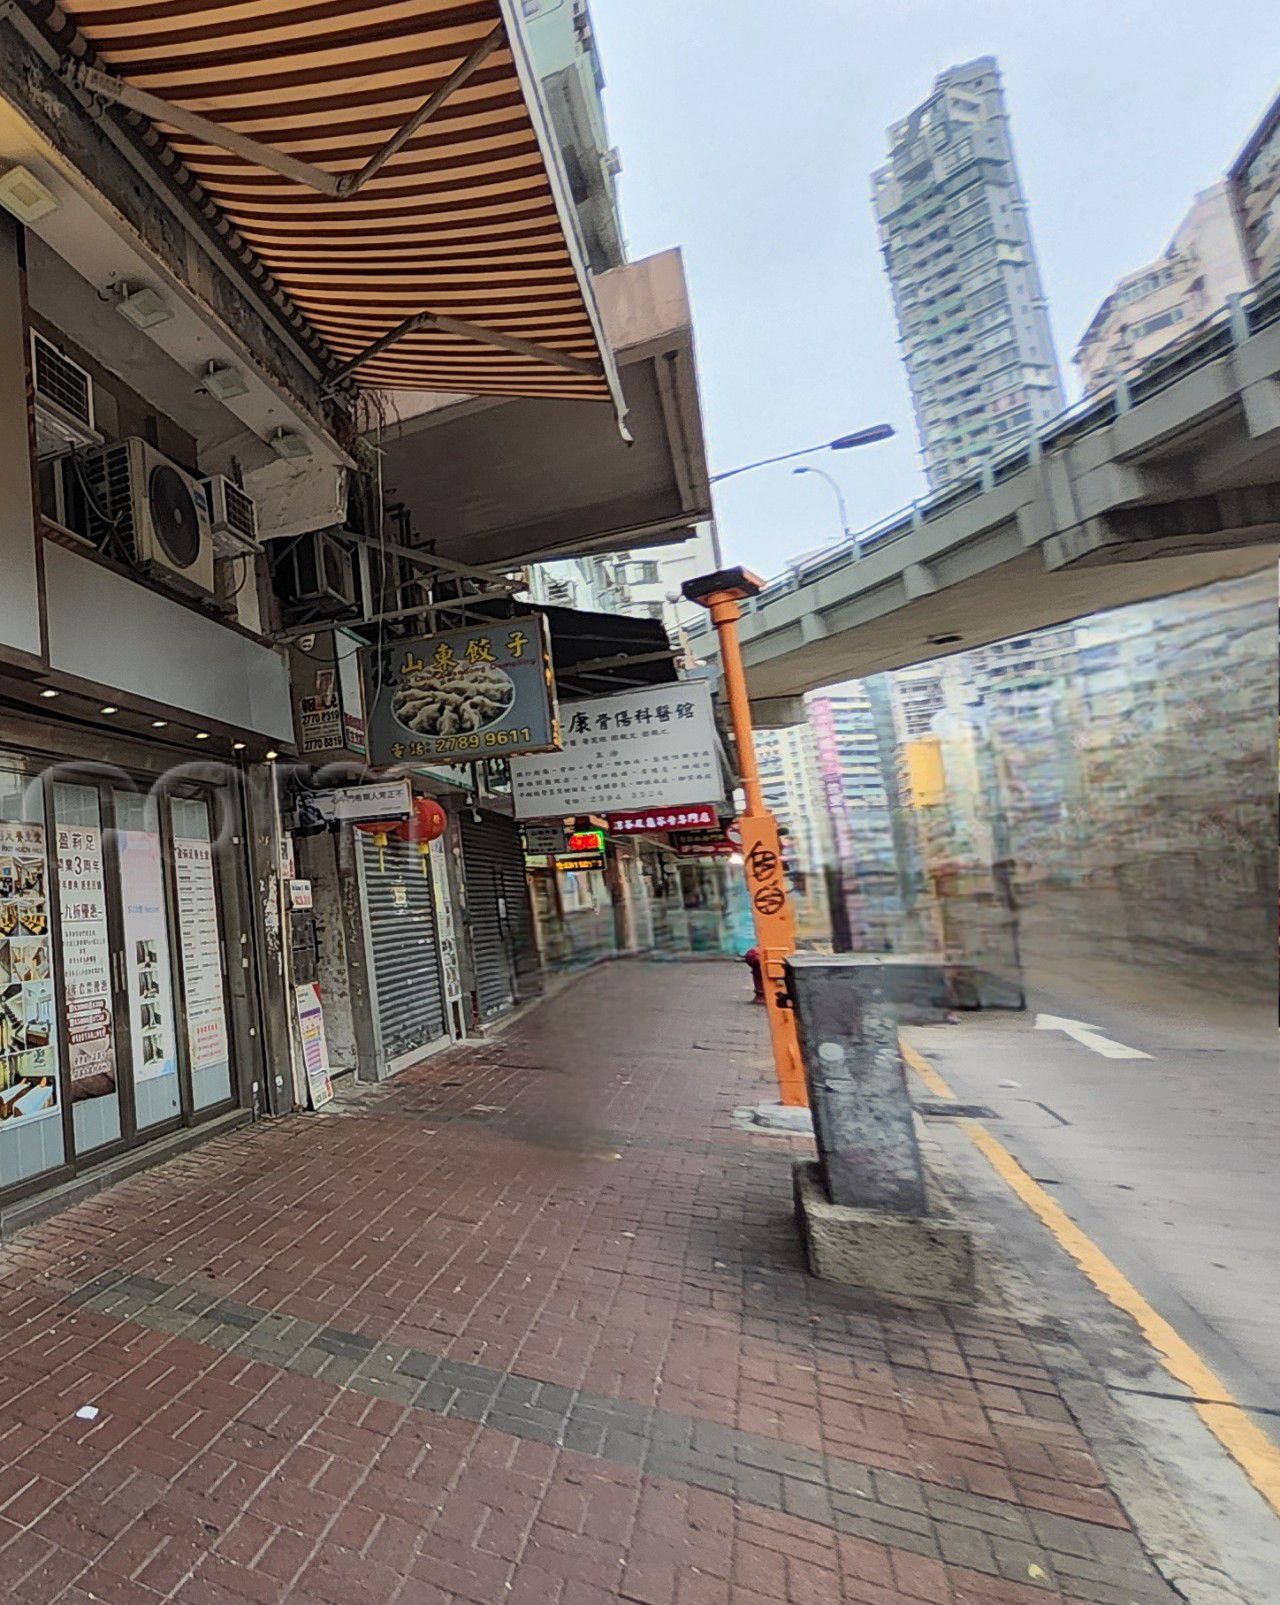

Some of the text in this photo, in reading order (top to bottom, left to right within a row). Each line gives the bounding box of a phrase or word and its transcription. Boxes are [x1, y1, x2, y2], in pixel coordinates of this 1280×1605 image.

[401, 631, 528, 674] 山東餃子
[561, 701, 695, 735] 康骨傷科醫館
[435, 734, 480, 753] 2789
[485, 728, 531, 746] 9611
